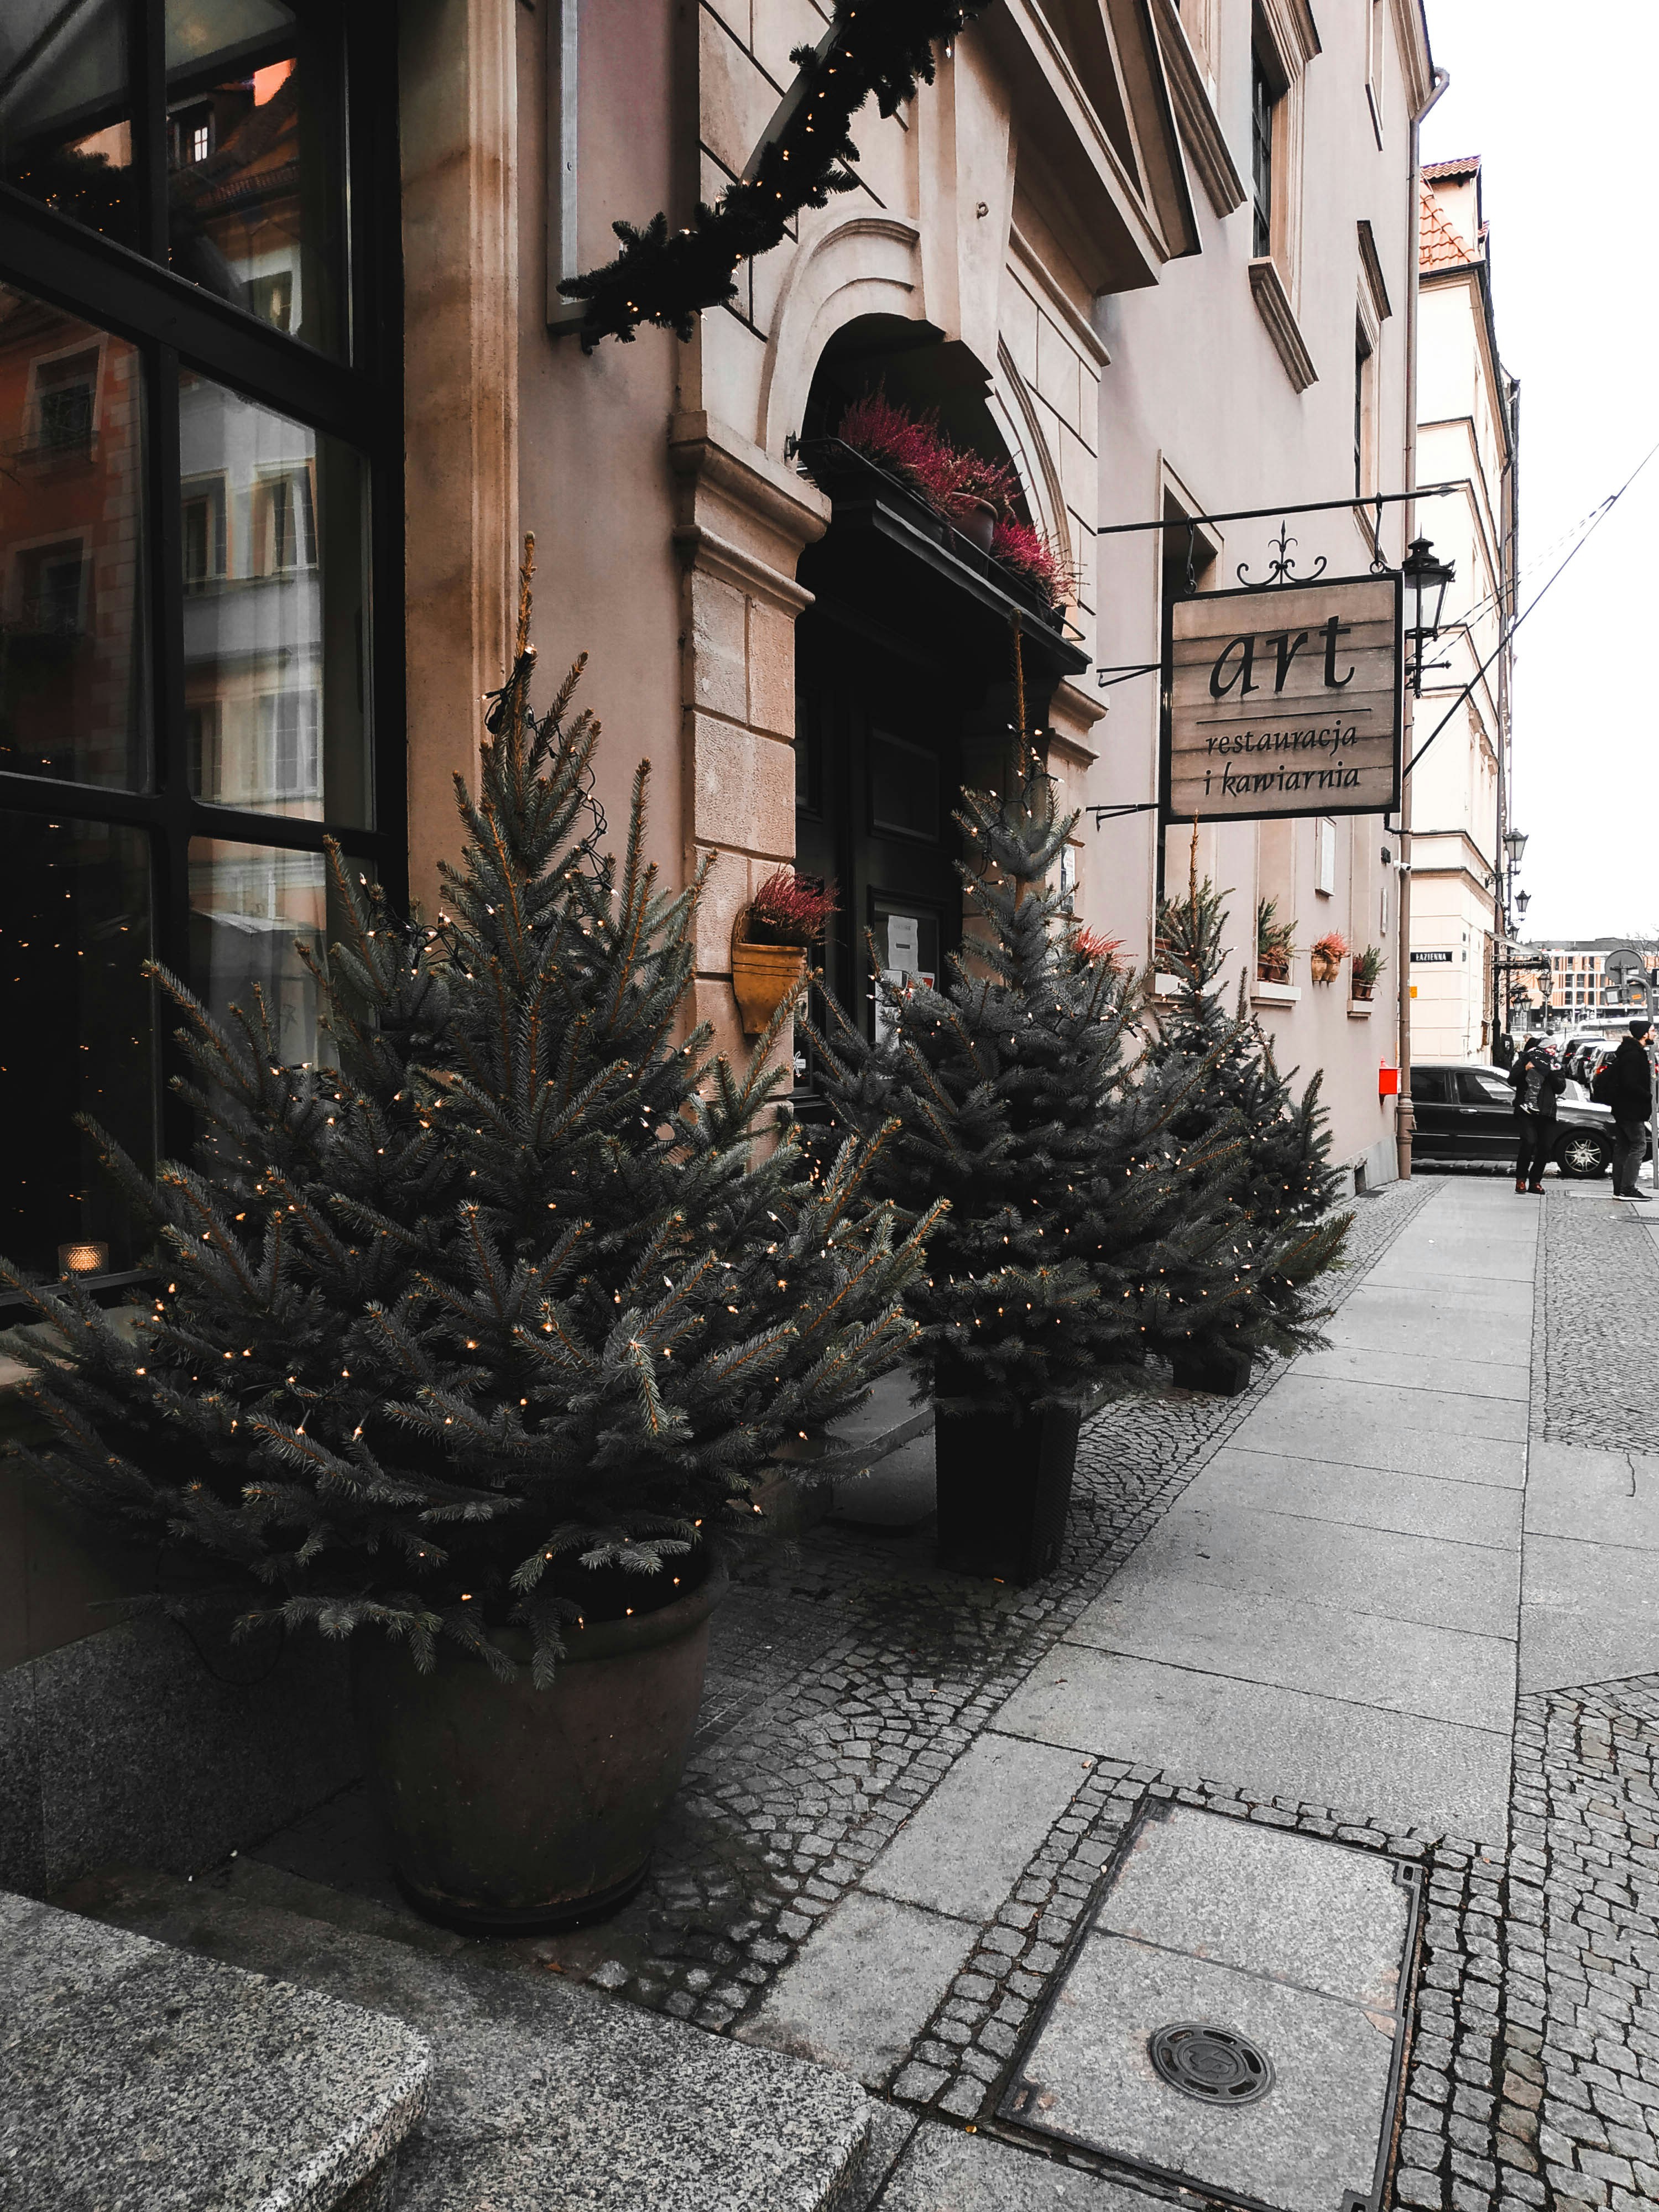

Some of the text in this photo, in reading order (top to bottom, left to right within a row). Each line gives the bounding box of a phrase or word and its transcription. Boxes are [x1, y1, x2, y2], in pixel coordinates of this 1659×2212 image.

[1209, 615, 1355, 697] art
[1206, 720, 1358, 756] restauracja
[1203, 761, 1359, 797] i kawiarnia
[1416, 953, 1447, 961] ŁAZIENNA
